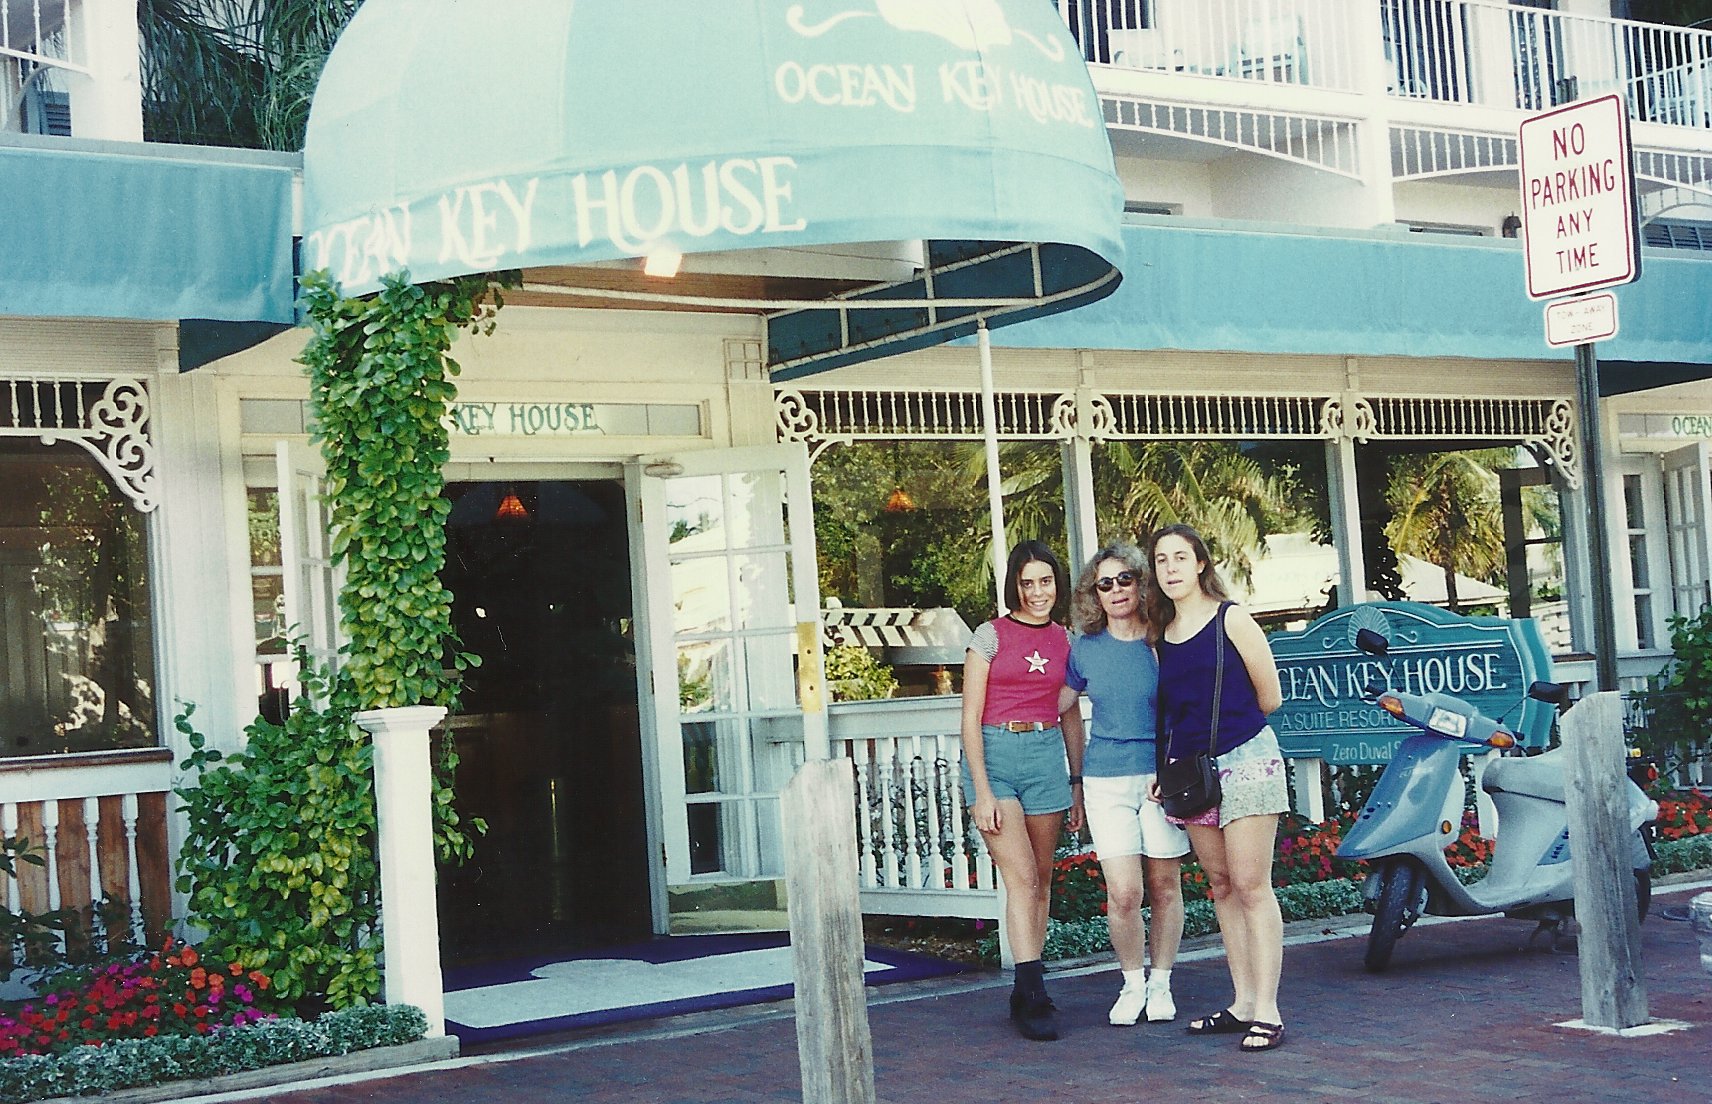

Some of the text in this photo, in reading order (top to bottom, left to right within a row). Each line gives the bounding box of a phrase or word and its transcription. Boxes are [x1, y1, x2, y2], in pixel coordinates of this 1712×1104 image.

[775, 60, 1095, 128] OCEAN KEY HOUSE
[1553, 123, 1585, 161] NO
[1531, 159, 1615, 210] PARKING
[438, 177, 539, 269] KEY
[572, 156, 807, 256] HOUSE
[1556, 208, 1593, 239] ANY
[1556, 243, 1600, 274] TIME
[452, 402, 599, 435] KEY HOUSE
[1277, 653, 1507, 708] CEAN KEY HOUSE
[1280, 713, 1292, 730] A
[1294, 711, 1335, 730] SUITE
[1332, 743, 1358, 761] Zero
[1359, 741, 1392, 760] Duval
